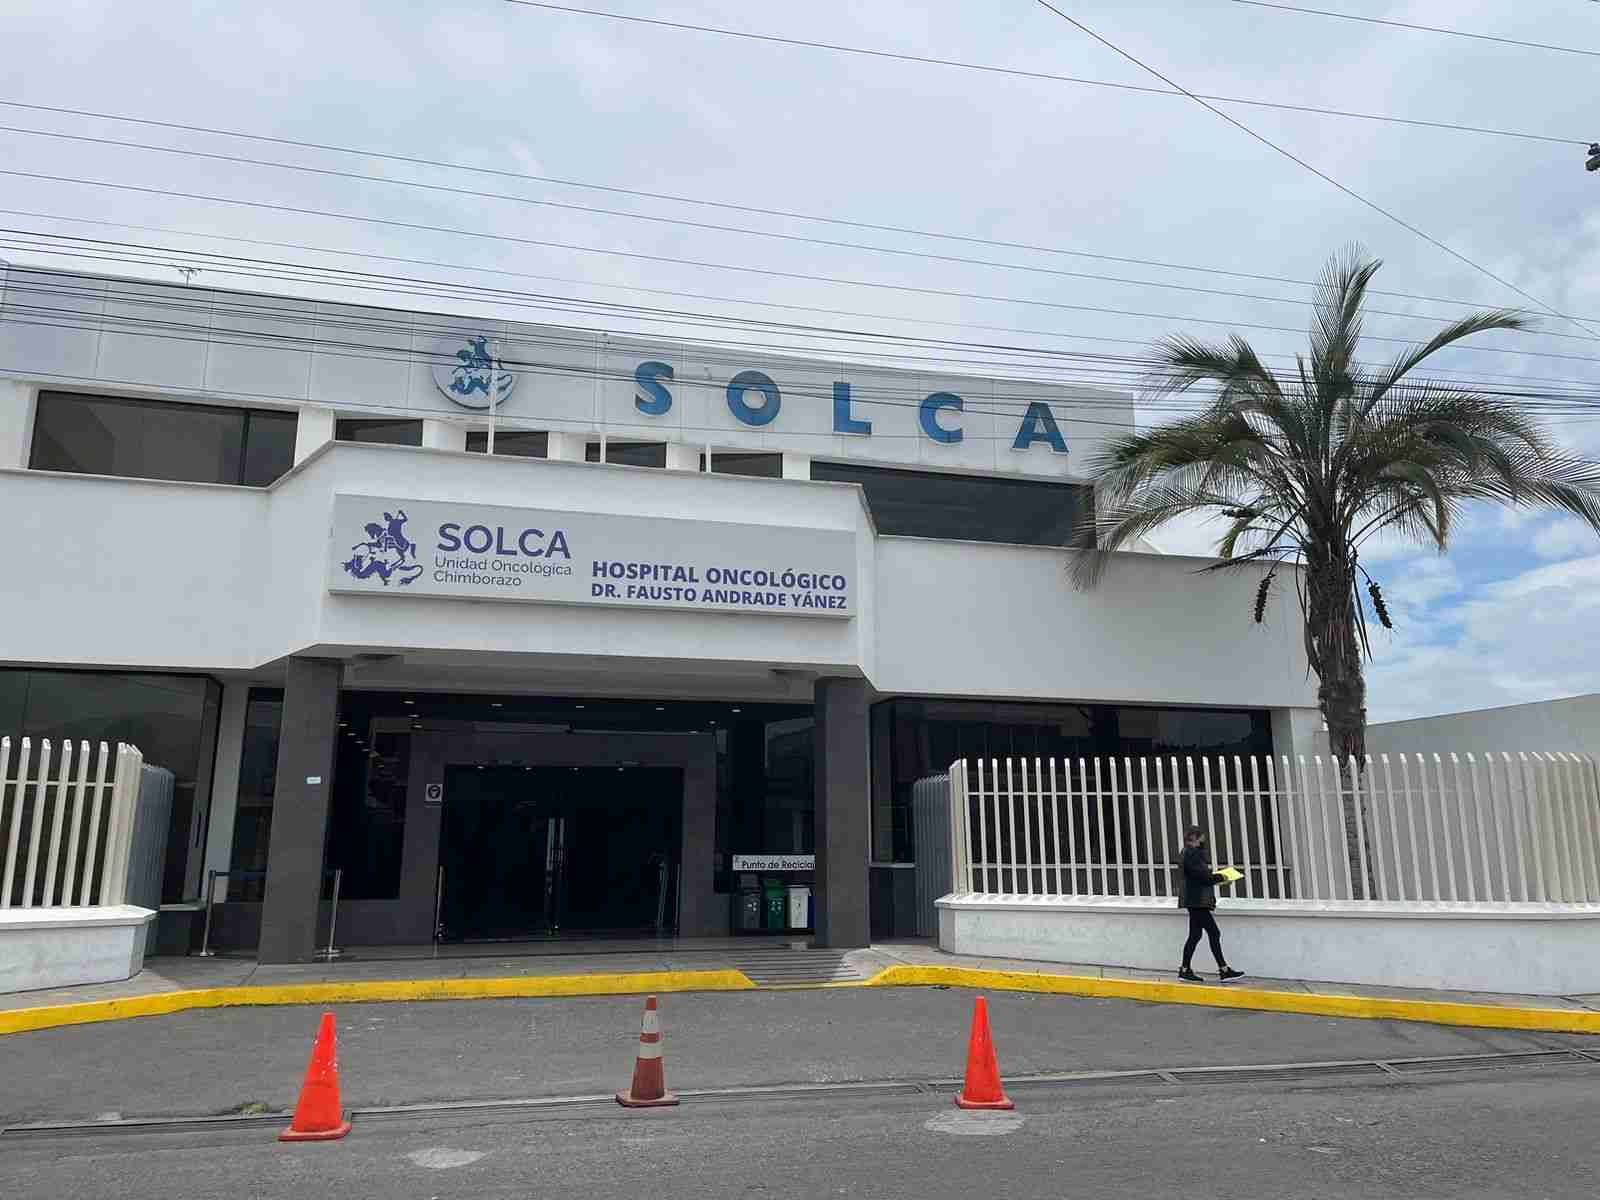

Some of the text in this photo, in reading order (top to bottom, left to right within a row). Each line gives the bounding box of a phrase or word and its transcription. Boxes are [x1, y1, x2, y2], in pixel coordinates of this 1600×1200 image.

[635, 361, 1070, 454] SOLCA
[437, 523, 571, 559] SOLCA
[434, 557, 487, 571] Unidad
[592, 561, 846, 591] HOSPITAL ONCOLÓGICO
[433, 570, 522, 586] Chimborazo
[592, 583, 847, 609] DR. FAUSTO ANDRADE YÁNEZ
[742, 861, 815, 869] Punto de Recicla
